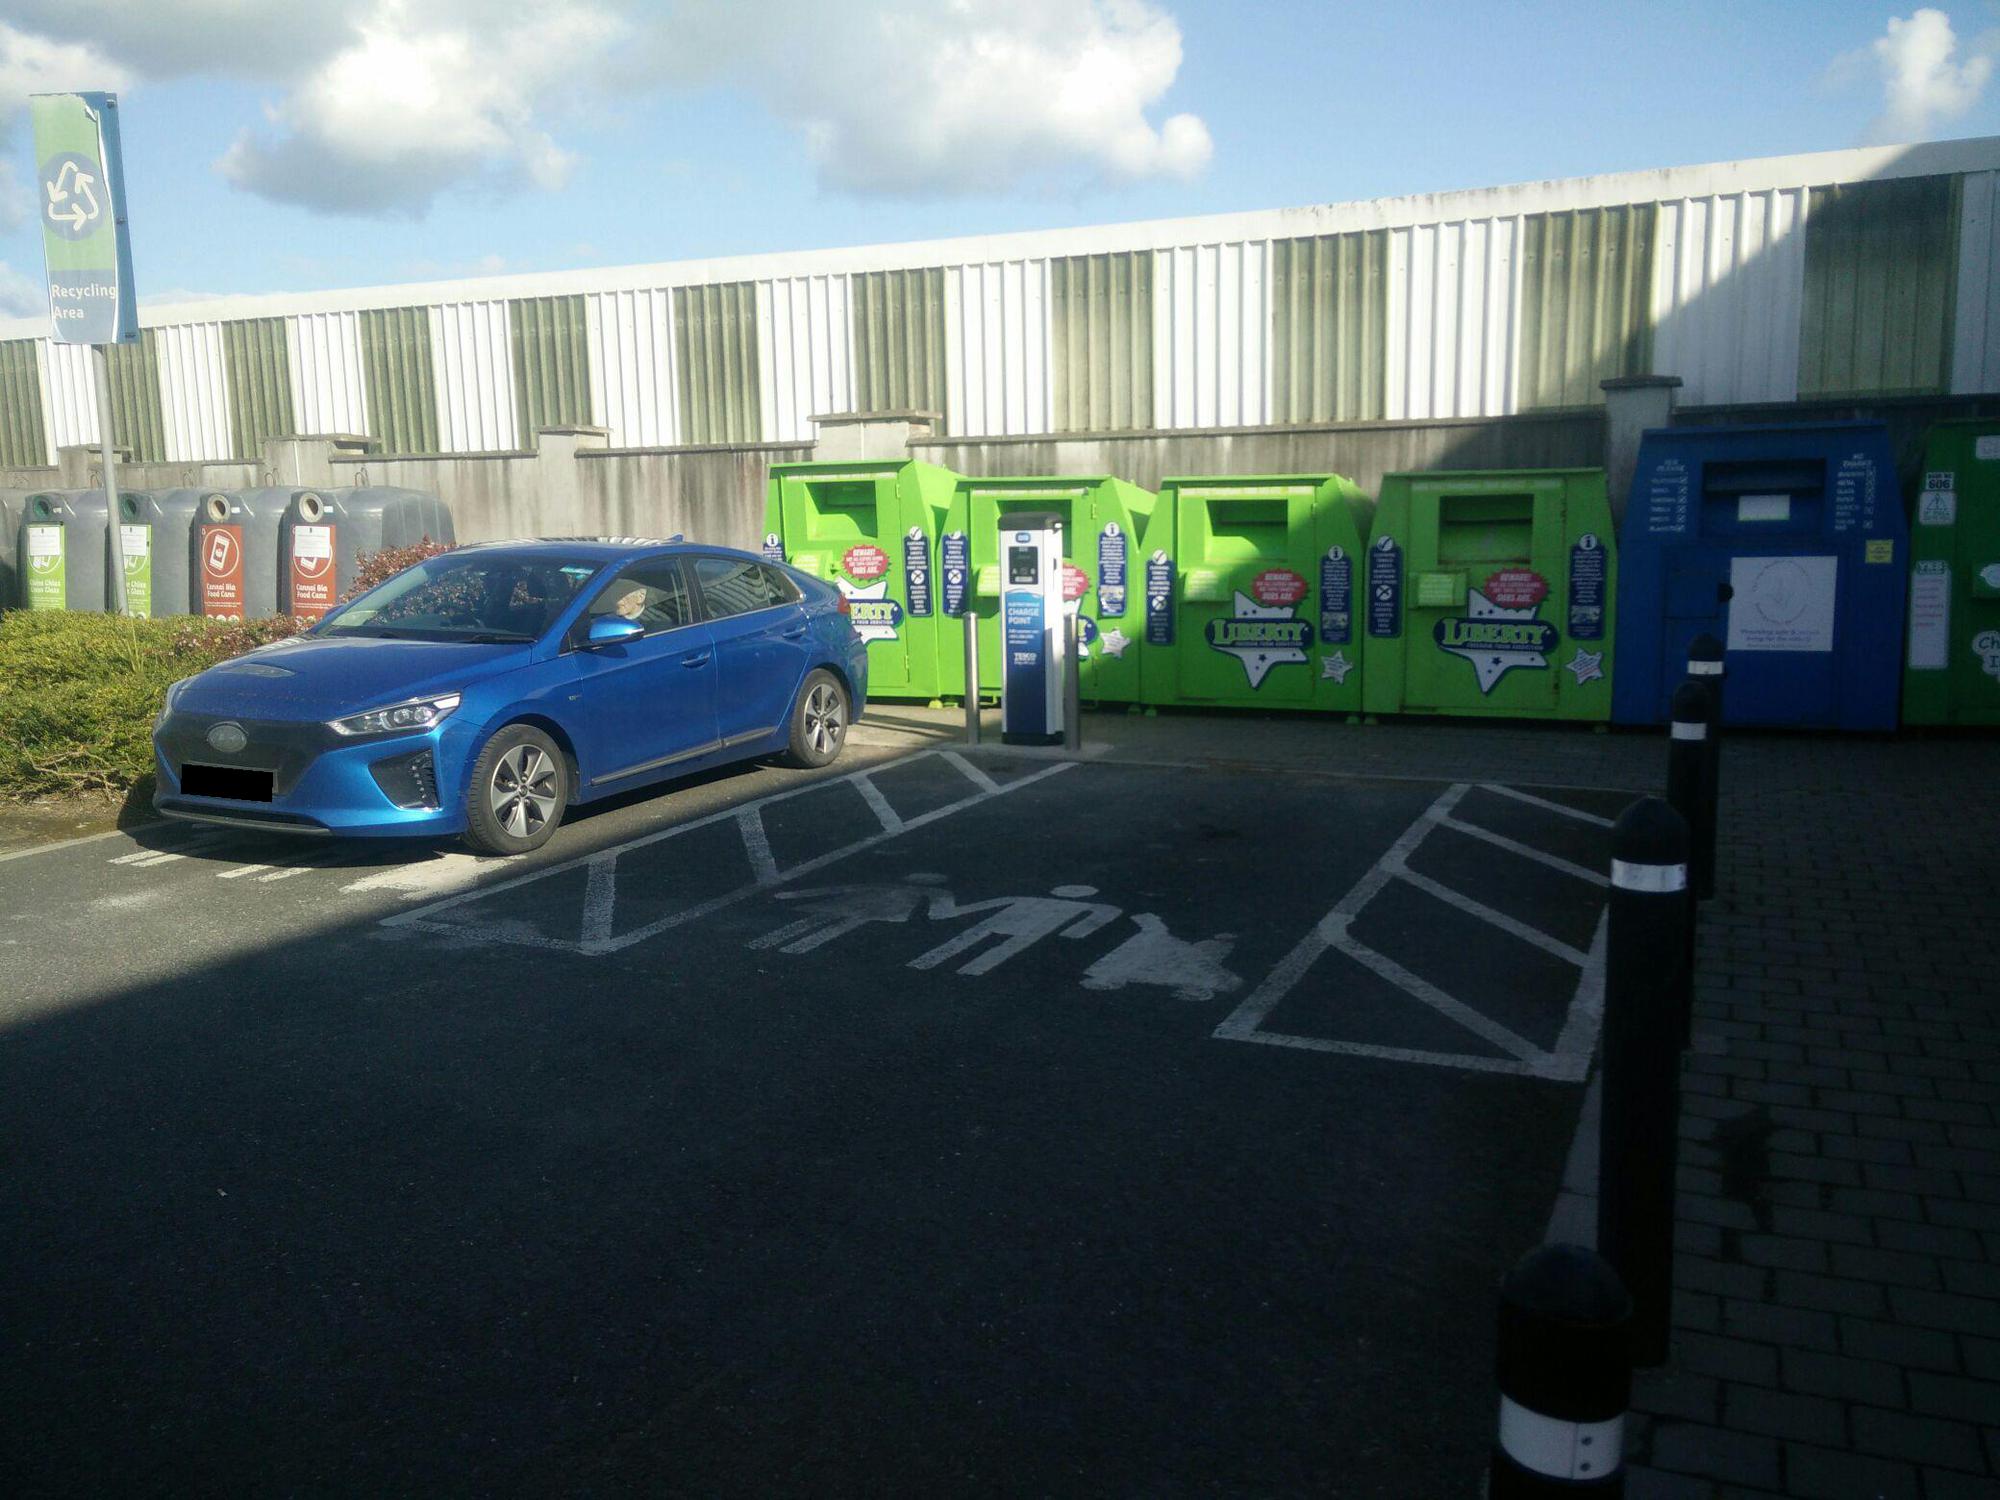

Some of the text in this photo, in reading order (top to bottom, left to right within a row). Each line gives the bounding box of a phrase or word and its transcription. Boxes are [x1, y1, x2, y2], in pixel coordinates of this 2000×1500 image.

[52, 283, 117, 300] Recycling
[53, 305, 84, 319] Area
[297, 591, 328, 600] Food Cans
[850, 602, 896, 620] ERTY
[1008, 607, 1040, 617] CHARGE
[1008, 616, 1032, 625] POINT
[1211, 619, 1307, 645] LIBERTY
[1440, 617, 1549, 646] LIBERTY
